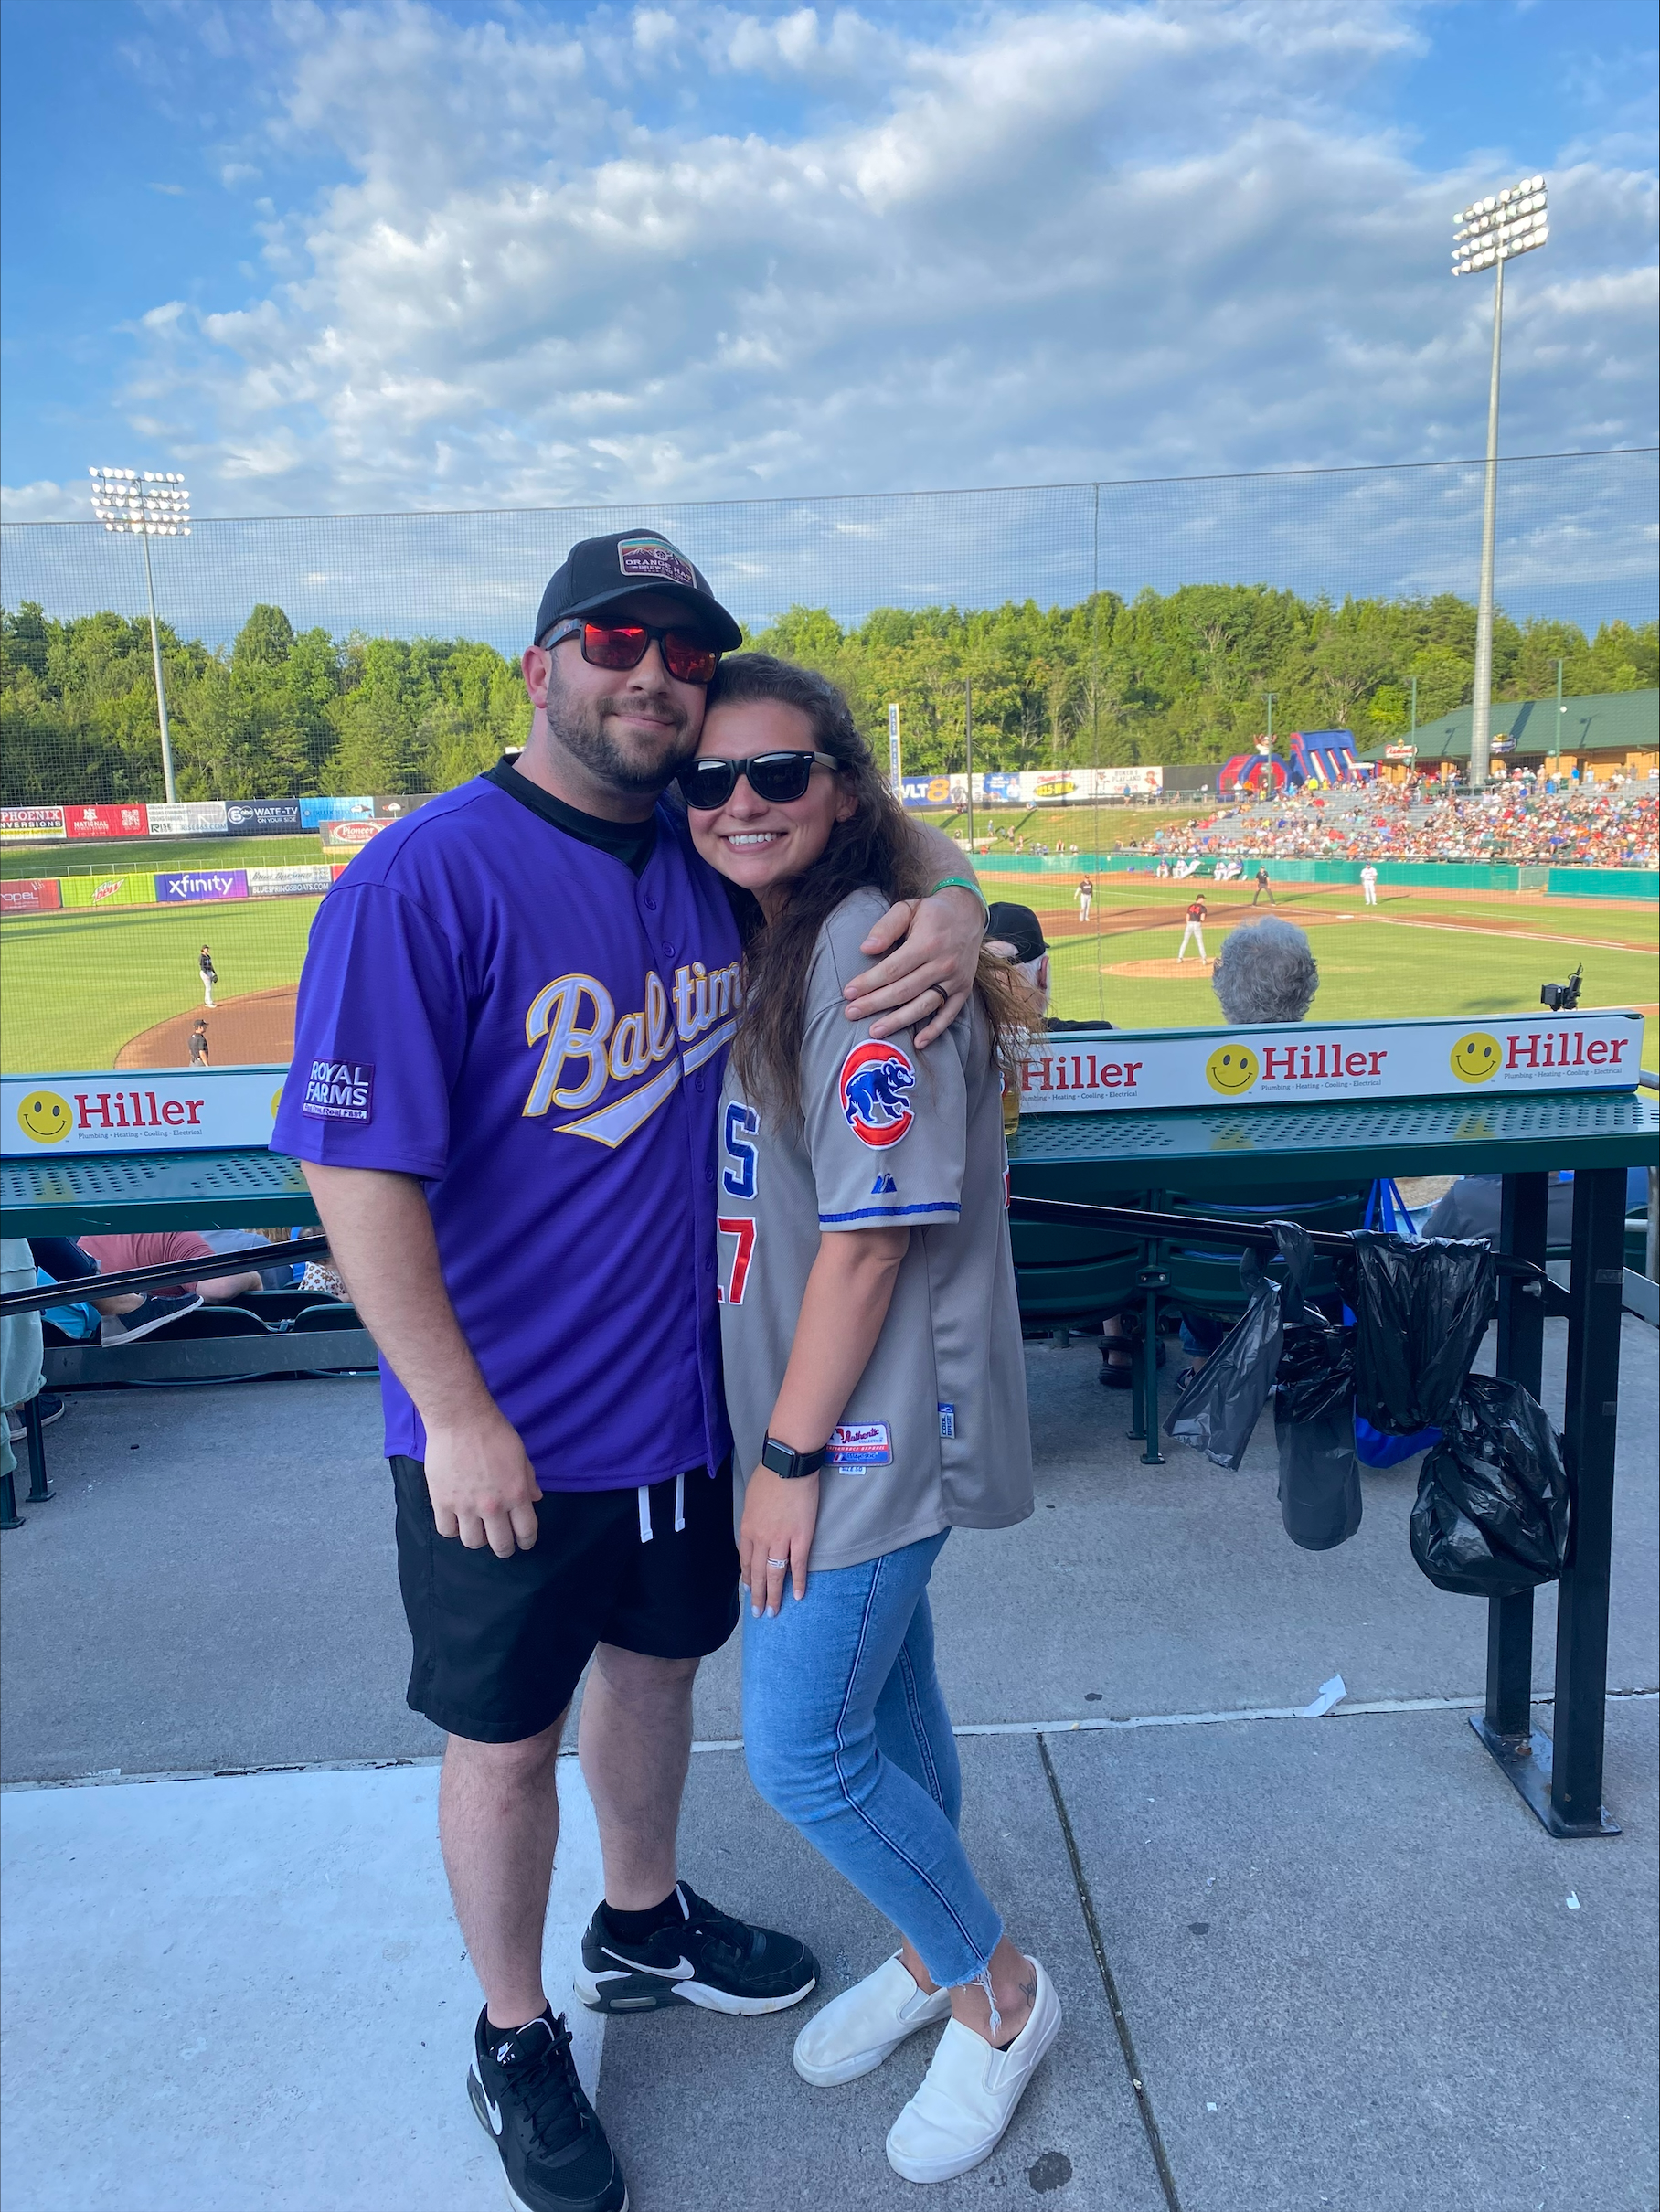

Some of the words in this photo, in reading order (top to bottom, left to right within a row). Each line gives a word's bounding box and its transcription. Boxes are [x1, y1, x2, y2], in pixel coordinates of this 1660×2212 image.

[626, 559, 671, 569] ORANGE
[674, 567, 692, 581] HAT
[639, 565, 673, 575] BREWING
[1, 810, 61, 822] PHOENIX
[254, 807, 298, 815] WATE-TV
[342, 826, 374, 835] Pioneer
[169, 875, 234, 898] xfinity
[252, 883, 329, 894] BLUESPRINGSBOATS.COM
[1261, 1044, 1388, 1080] Hiller
[1506, 1032, 1629, 1069] Hiller
[310, 1061, 369, 1087] ROYAL
[1021, 1055, 1143, 1090] Hiller
[305, 1081, 367, 1106] FARMS
[74, 1091, 205, 1128] Hiller
[718, 1215, 758, 1305] 7
[842, 1427, 879, 1444] Authentic
